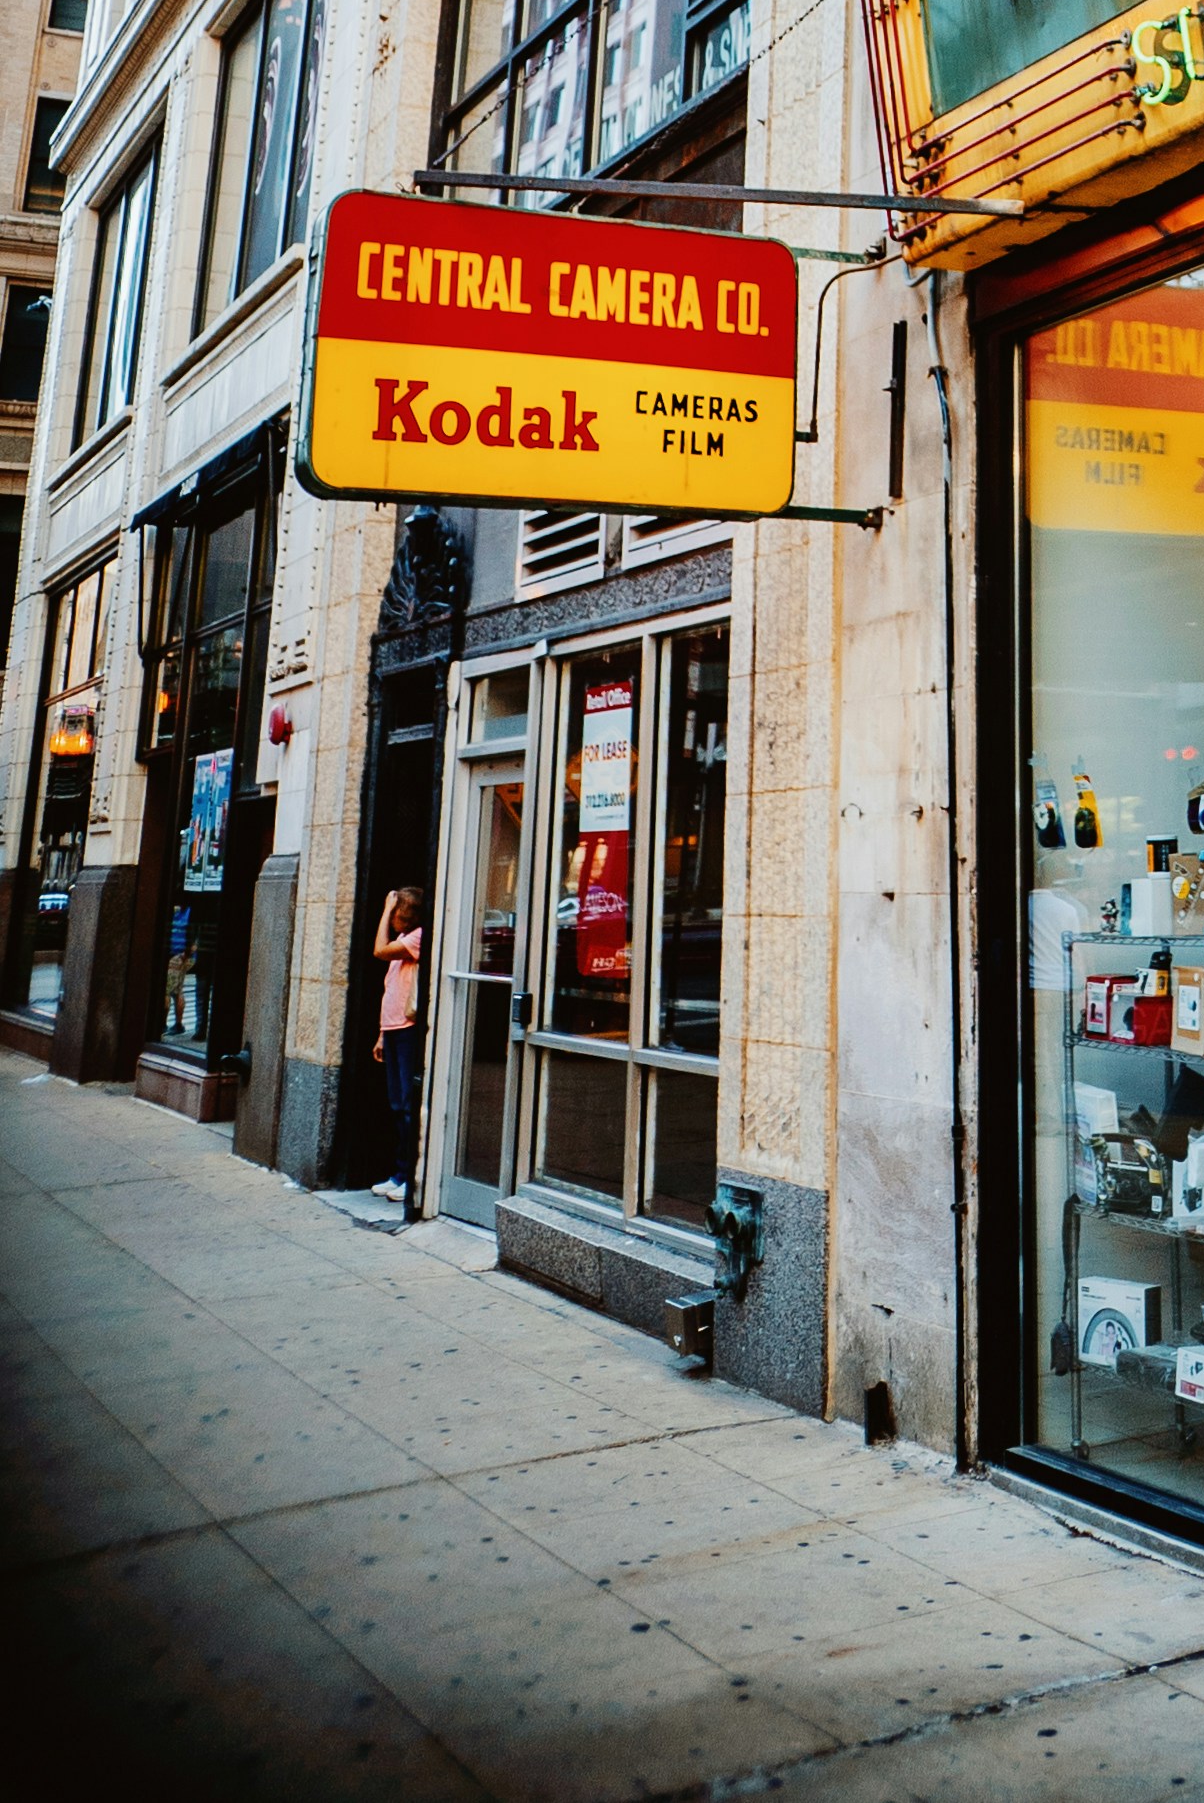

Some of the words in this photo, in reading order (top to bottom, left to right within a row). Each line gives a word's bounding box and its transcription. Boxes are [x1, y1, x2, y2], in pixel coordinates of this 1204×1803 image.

[357, 241, 531, 315] CENTRAL
[549, 261, 703, 331] CAMERA
[717, 280, 770, 337] CO.
[372, 378, 600, 452] Kodak
[636, 390, 758, 423] CAMERAS
[662, 429, 725, 458] FILM
[584, 744, 600, 764] FOR
[602, 740, 628, 761] LEASE
